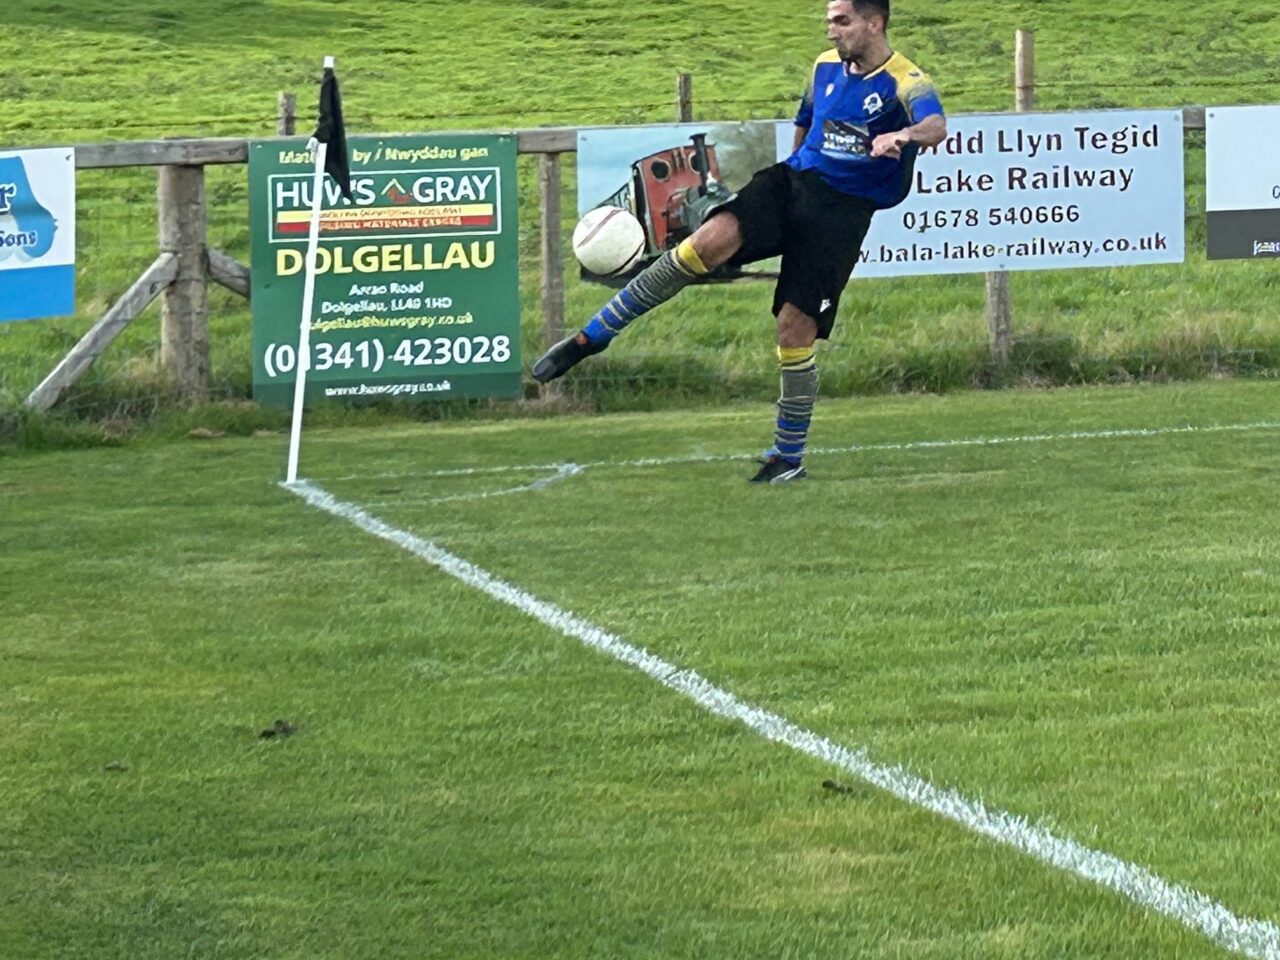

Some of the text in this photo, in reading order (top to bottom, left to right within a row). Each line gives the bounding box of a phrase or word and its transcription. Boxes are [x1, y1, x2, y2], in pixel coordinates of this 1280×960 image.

[997, 128, 1063, 158] Llyn
[1074, 123, 1160, 155] Tegid
[411, 173, 493, 204] GRAY
[915, 164, 1135, 195] Lake Railway
[902, 203, 1081, 232] 01678 540666
[276, 240, 496, 277] DOLGELLAU
[857, 232, 1168, 264] w.bala-lake-railway.co.uk
[392, 334, 512, 367] 423028
